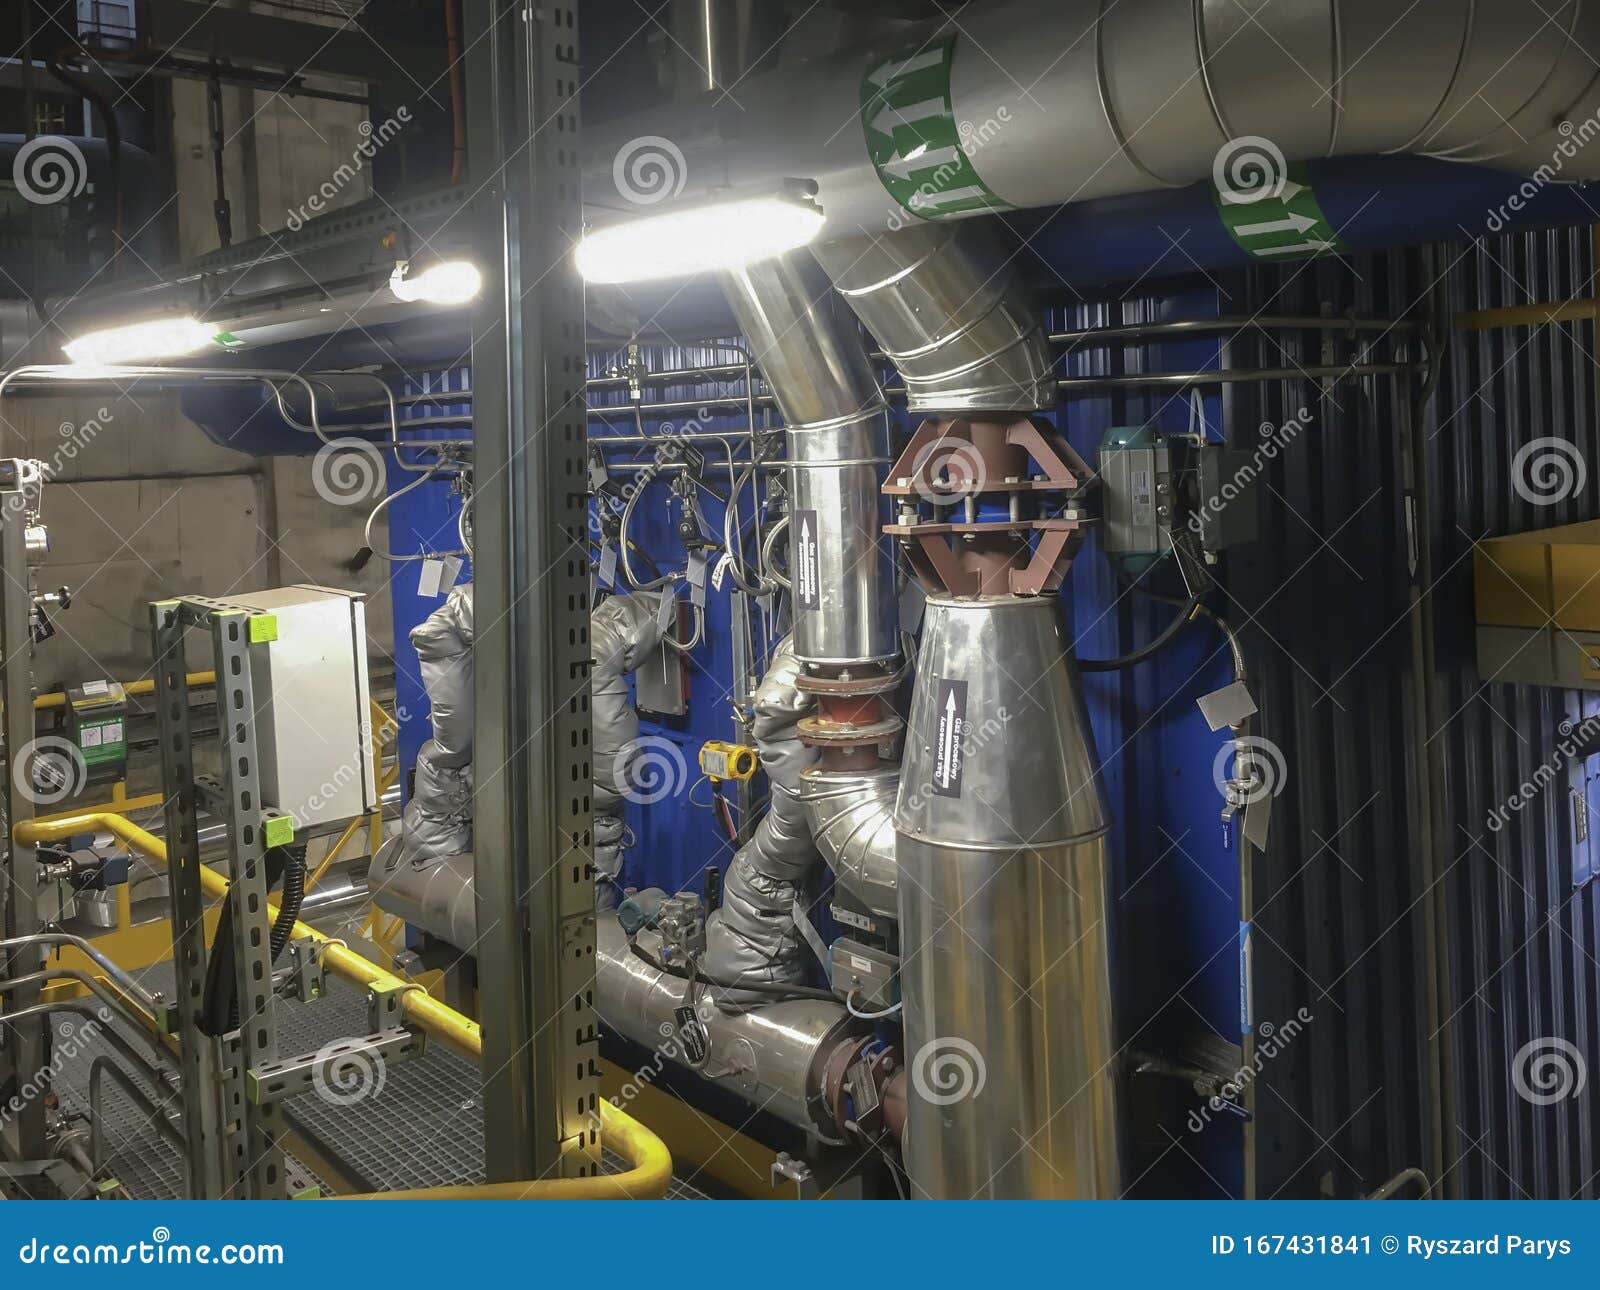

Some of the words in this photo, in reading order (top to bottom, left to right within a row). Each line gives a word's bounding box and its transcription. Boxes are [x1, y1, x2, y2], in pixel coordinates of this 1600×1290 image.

[937, 716, 946, 760] procesowy
[954, 718, 962, 733] Gaz
[935, 762, 943, 777] Gaz
[950, 735, 960, 779] procesowy
